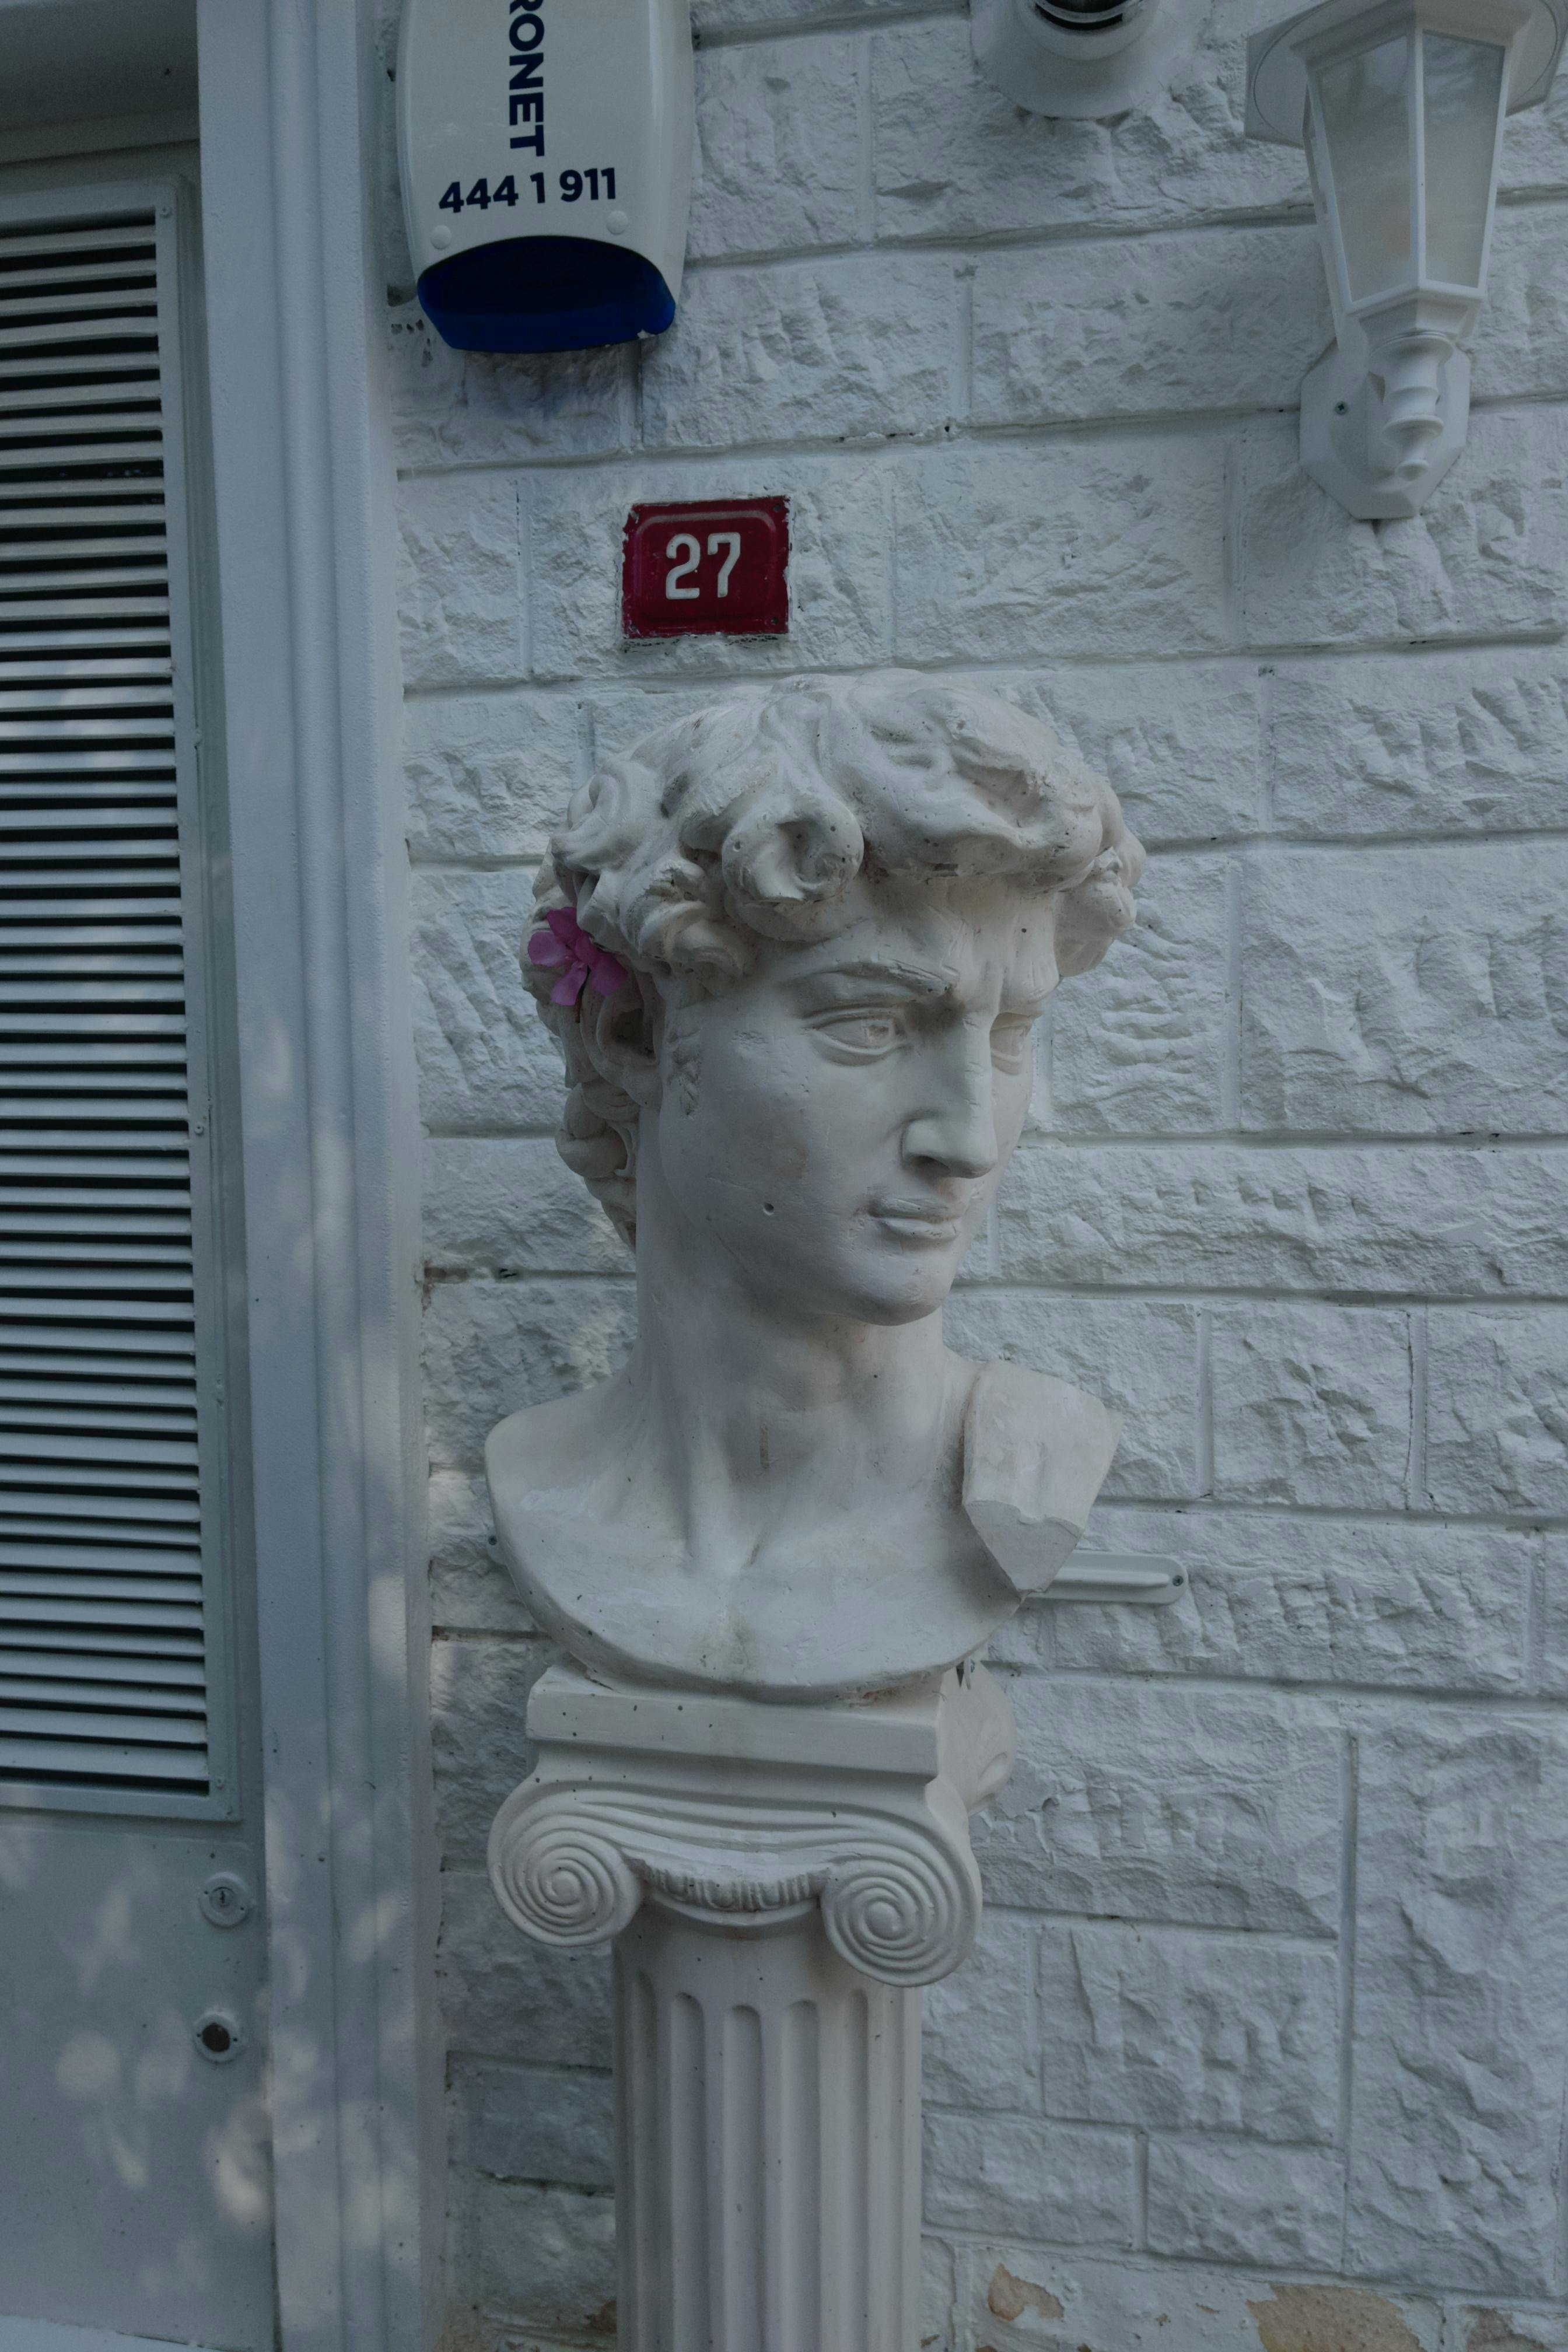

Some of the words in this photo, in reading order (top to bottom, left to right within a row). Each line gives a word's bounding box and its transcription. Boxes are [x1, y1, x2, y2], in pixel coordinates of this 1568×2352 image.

[438, 175, 519, 214] 444
[530, 172, 545, 204] 1
[559, 167, 616, 202] 911
[666, 532, 741, 600] 27
